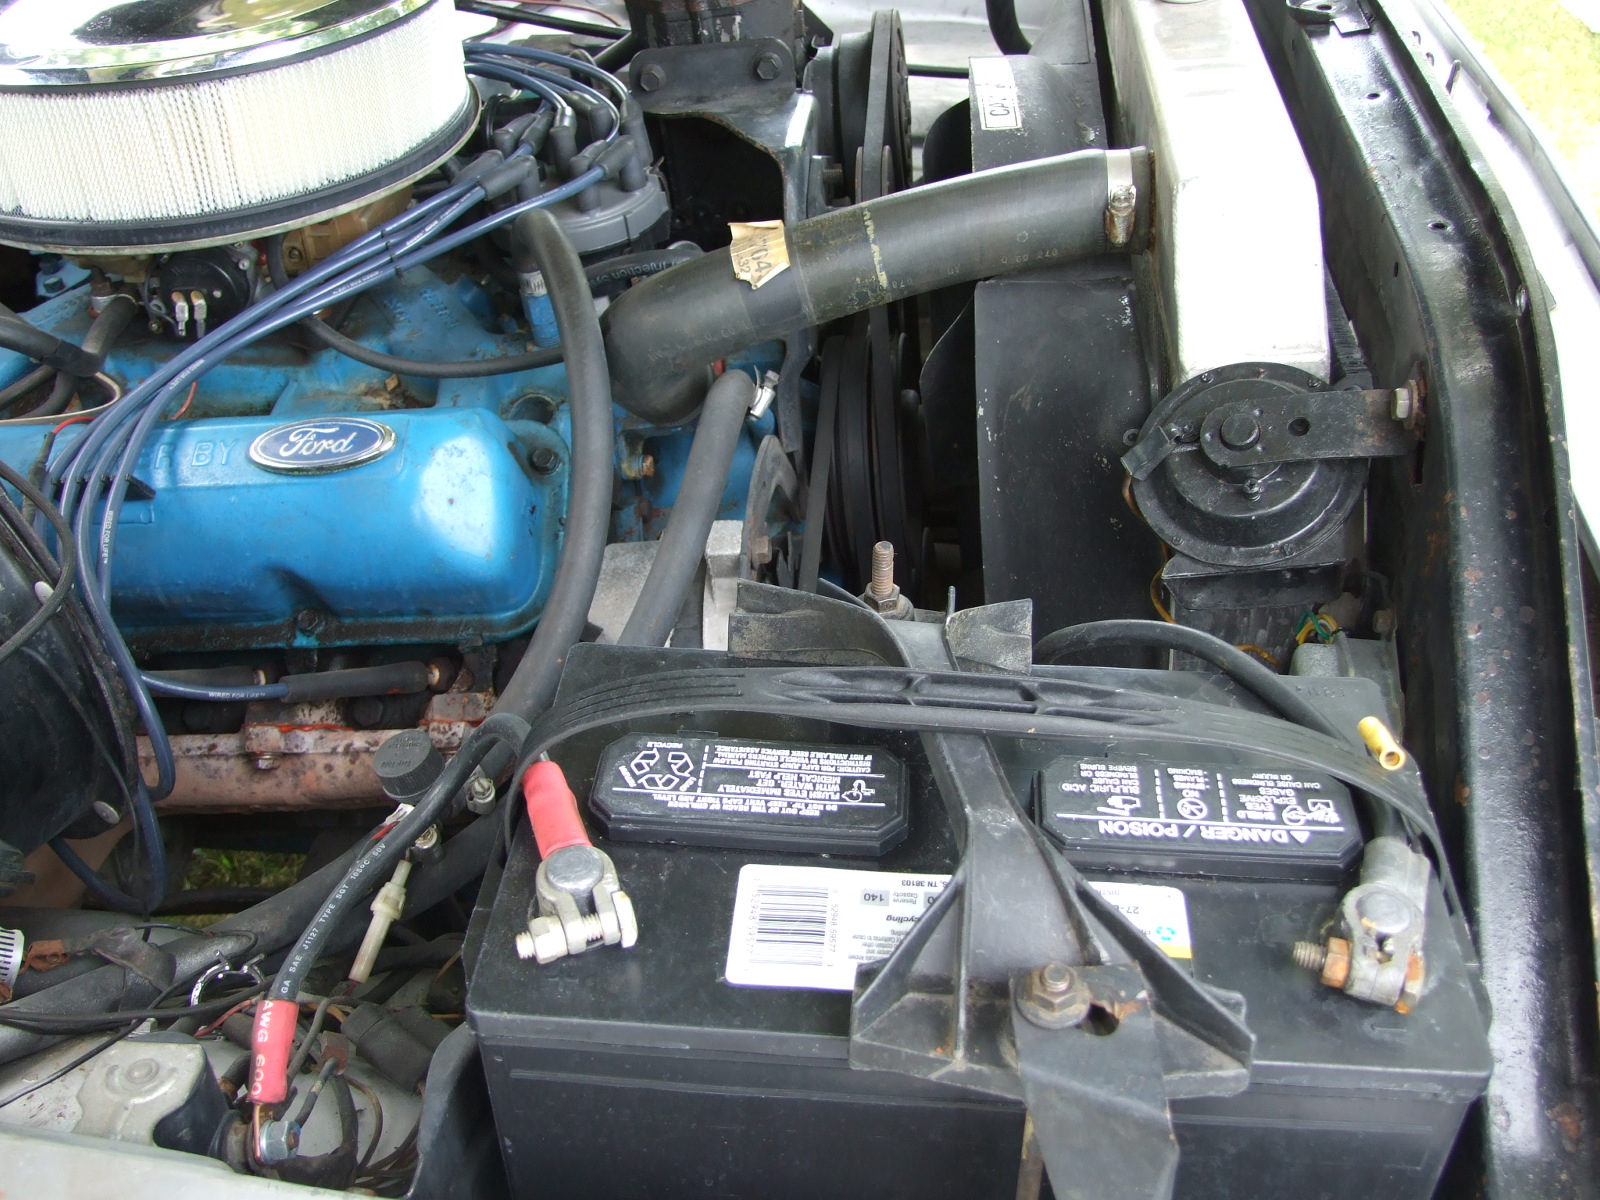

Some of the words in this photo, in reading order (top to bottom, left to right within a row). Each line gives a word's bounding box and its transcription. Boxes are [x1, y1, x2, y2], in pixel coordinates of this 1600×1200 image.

[280, 427, 358, 457] Ford
[192, 440, 236, 467] BY
[713, 758, 743, 766] FOLLOW
[744, 760, 779, 768] STARTING
[1080, 763, 1106, 771] BURNS
[748, 770, 772, 780] FAST
[773, 773, 798, 781] HELP
[1094, 770, 1138, 779] BLINDNESS
[1167, 768, 1203, 776] SMOKING
[756, 779, 776, 787] GET
[799, 774, 840, 784] MEDICAL
[1092, 777, 1120, 785] CAUSE
[1173, 774, 1204, 782] FLAMES
[1232, 778, 1275, 787] BLINDNESS
[816, 784, 840, 792] WITH
[1062, 783, 1087, 792] ACID
[1090, 783, 1140, 794] SULFURIC
[1173, 780, 1205, 790] SPARKS
[1276, 780, 1302, 788] CAUSE
[717, 784, 782, 796] IMMEDIATELY
[784, 790, 808, 798] EYES
[809, 790, 840, 800] FLUSH
[1182, 789, 1200, 798] NO
[1258, 786, 1295, 797] GASES
[1238, 794, 1297, 806] EXPLOSIVE
[1244, 802, 1274, 811] EYES
[1236, 810, 1276, 821] SHIELD
[1098, 820, 1180, 838] POISON
[1183, 824, 1196, 838] /
[1200, 825, 1289, 844] DANGER
[864, 892, 884, 902] 140
[830, 904, 838, 926] 52948
[281, 980, 292, 994] GA
[288, 954, 304, 974] SAE
[302, 928, 319, 951] J1127
[318, 904, 336, 924] TYPE
[335, 883, 350, 902] SGT
[828, 929, 836, 953] 59577
[256, 1000, 274, 1043] AWG
